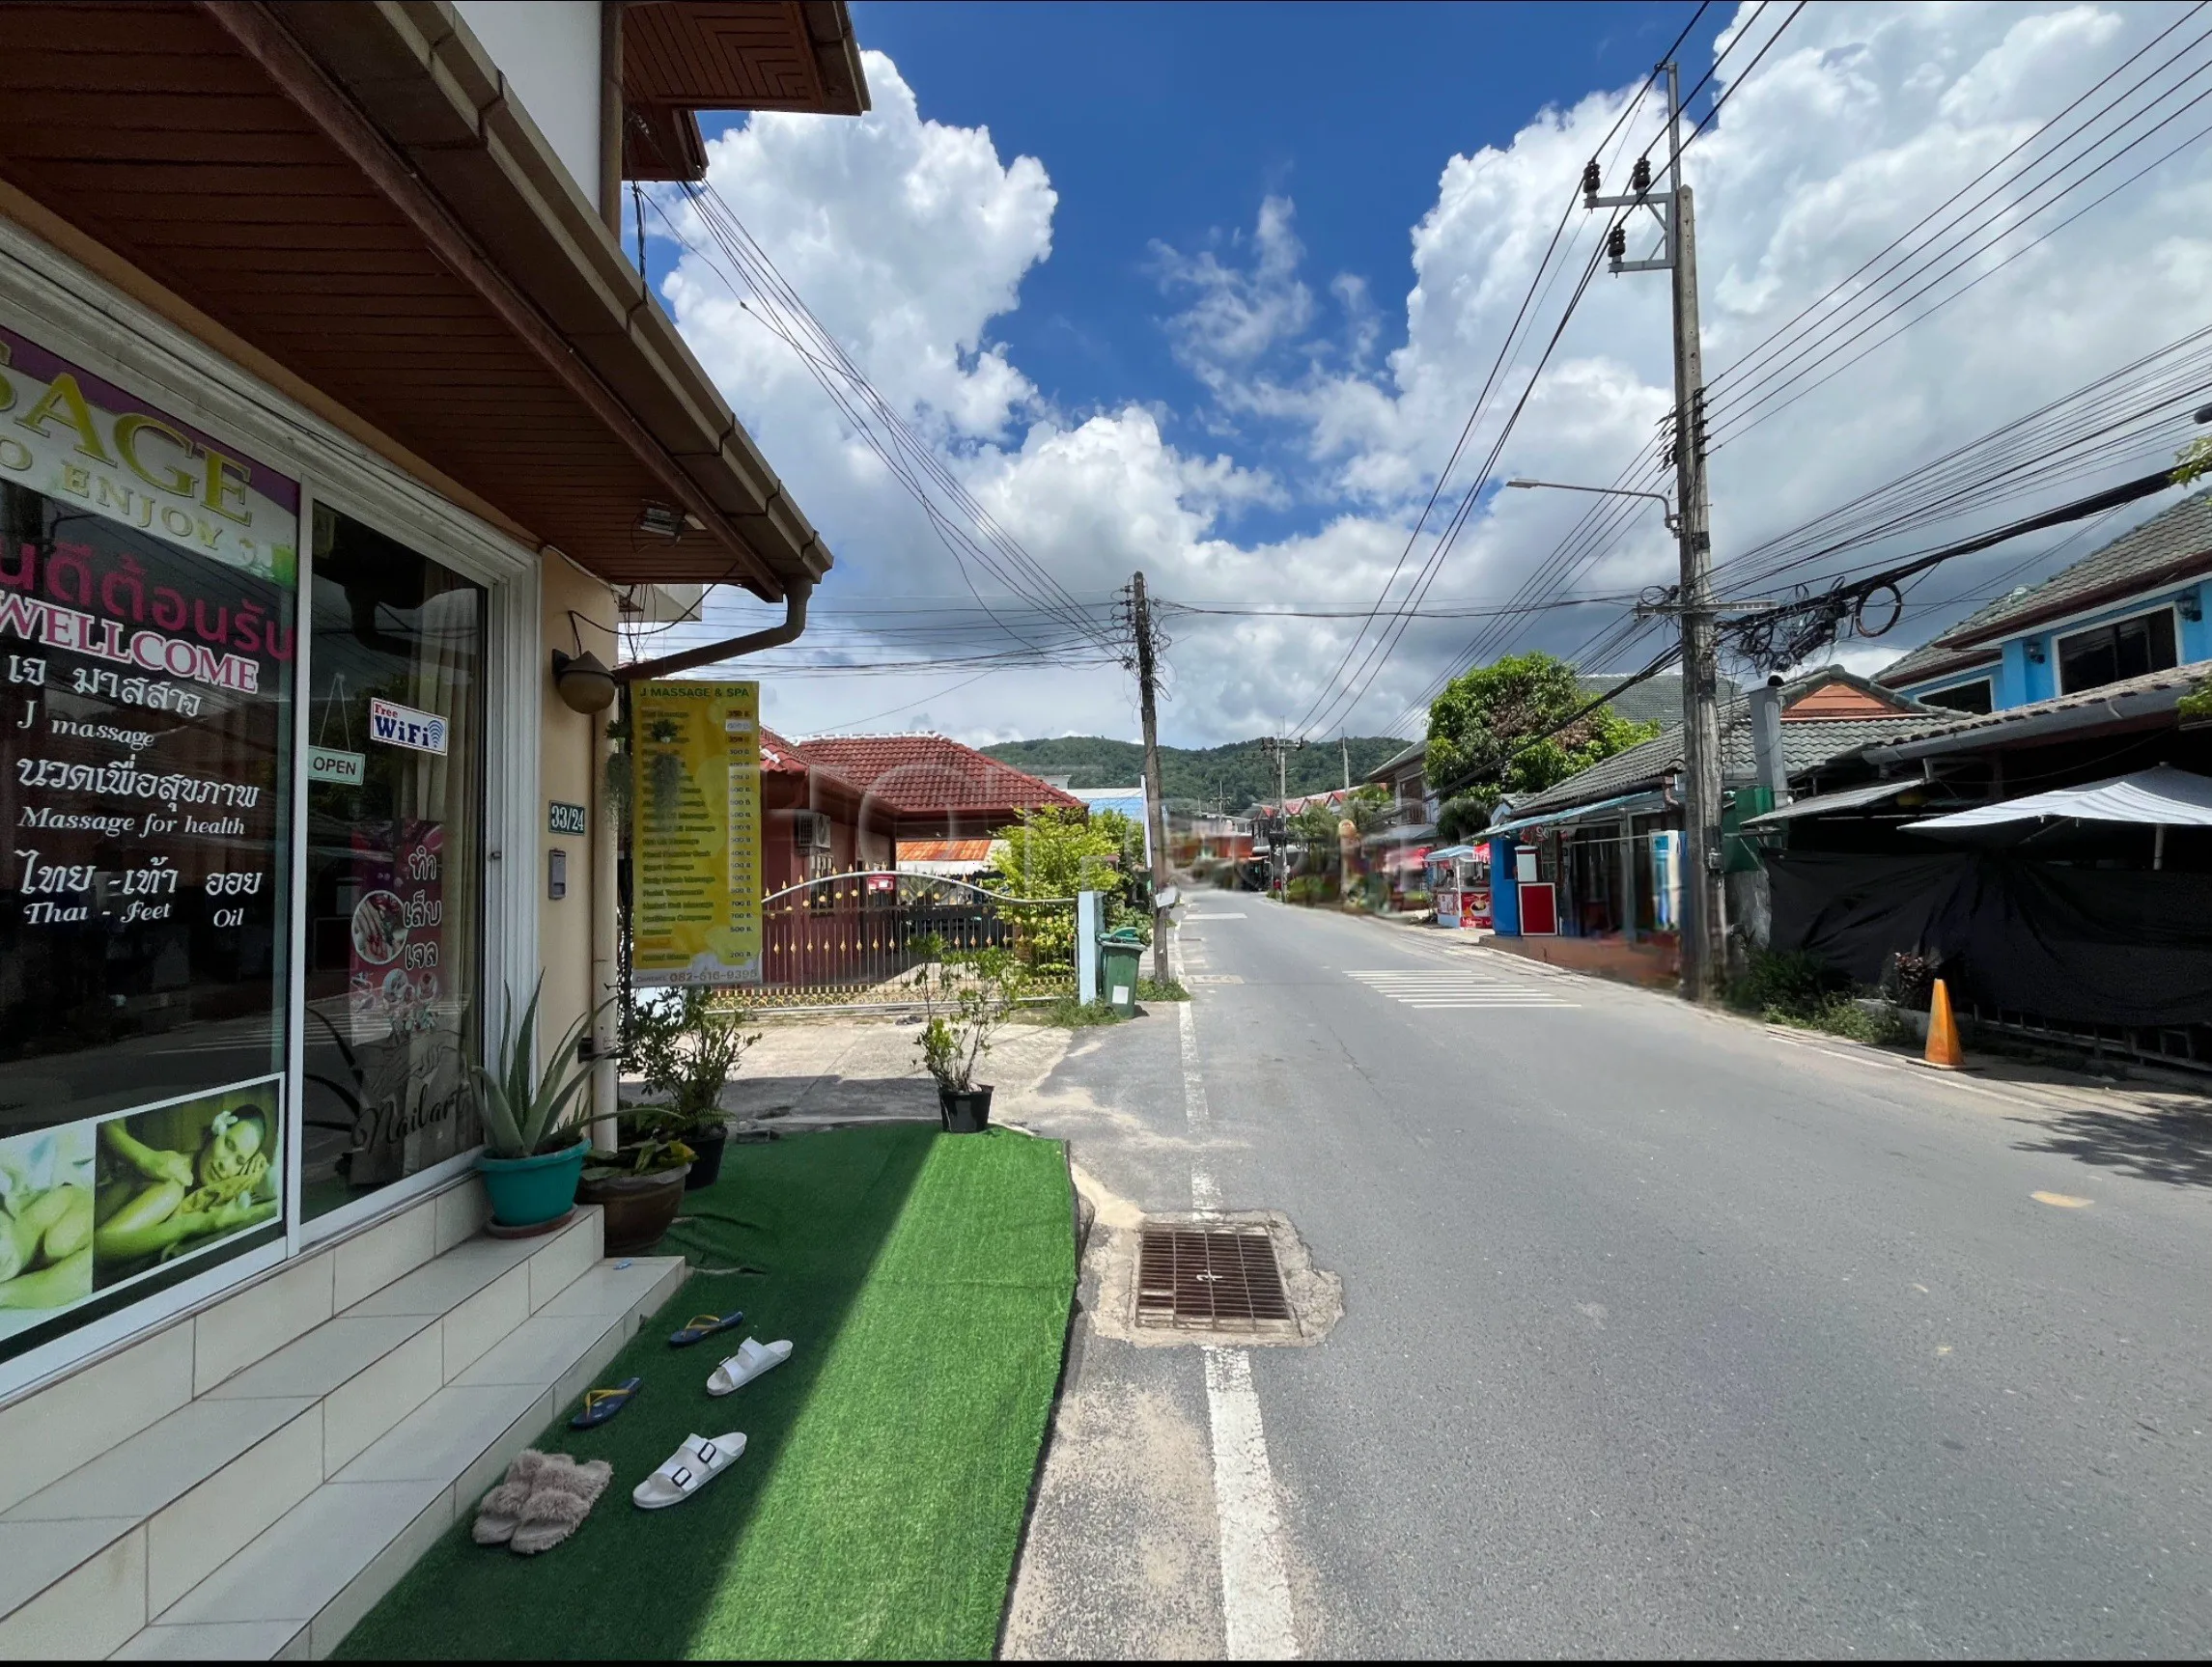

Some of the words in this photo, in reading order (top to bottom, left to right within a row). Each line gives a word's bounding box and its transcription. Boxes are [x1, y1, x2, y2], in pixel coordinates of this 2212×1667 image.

[62, 459, 223, 551] ENJOY
[640, 687, 647, 697] J
[650, 687, 711, 697] MASSAGE
[714, 687, 722, 697] &
[726, 687, 750, 697] SPA
[17, 700, 38, 729] J
[51, 719, 154, 751] massage
[374, 703, 398, 718] Free
[375, 715, 429, 747] WiFi
[313, 756, 356, 776] OPEN
[16, 806, 135, 837] Massage
[138, 813, 178, 838] for
[184, 815, 246, 835] health
[551, 805, 584, 831] 33/24
[14, 848, 97, 895] ไทย
[205, 872, 263, 896] ออย
[120, 900, 173, 924] Feet
[213, 907, 243, 928] Oil
